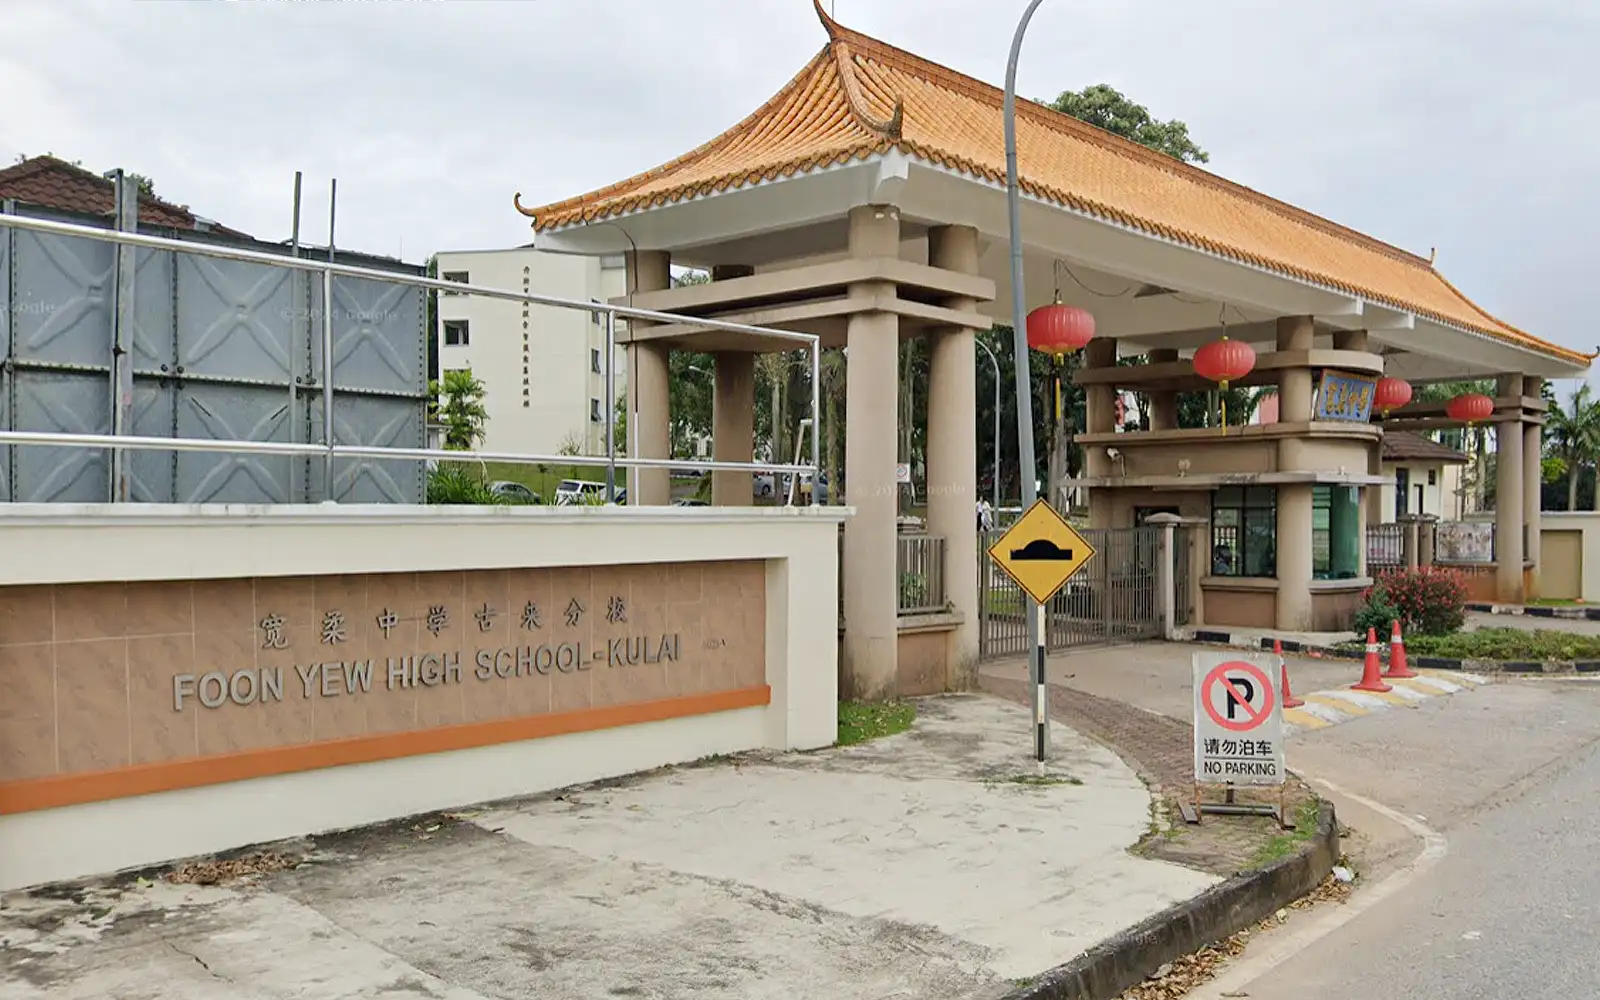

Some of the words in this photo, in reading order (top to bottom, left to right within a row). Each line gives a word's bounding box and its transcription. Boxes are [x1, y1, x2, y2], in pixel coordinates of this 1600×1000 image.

[259, 595, 628, 650] 宽柔中学古来分校
[172, 666, 284, 712] FOON
[295, 659, 374, 699] YEW
[386, 651, 462, 691] HIGH
[474, 633, 681, 683] SCHOOL-KULAI
[1204, 738, 1273, 757] 请勿泊车
[1204, 761, 1222, 774] NO
[1225, 761, 1276, 776] PARKING
